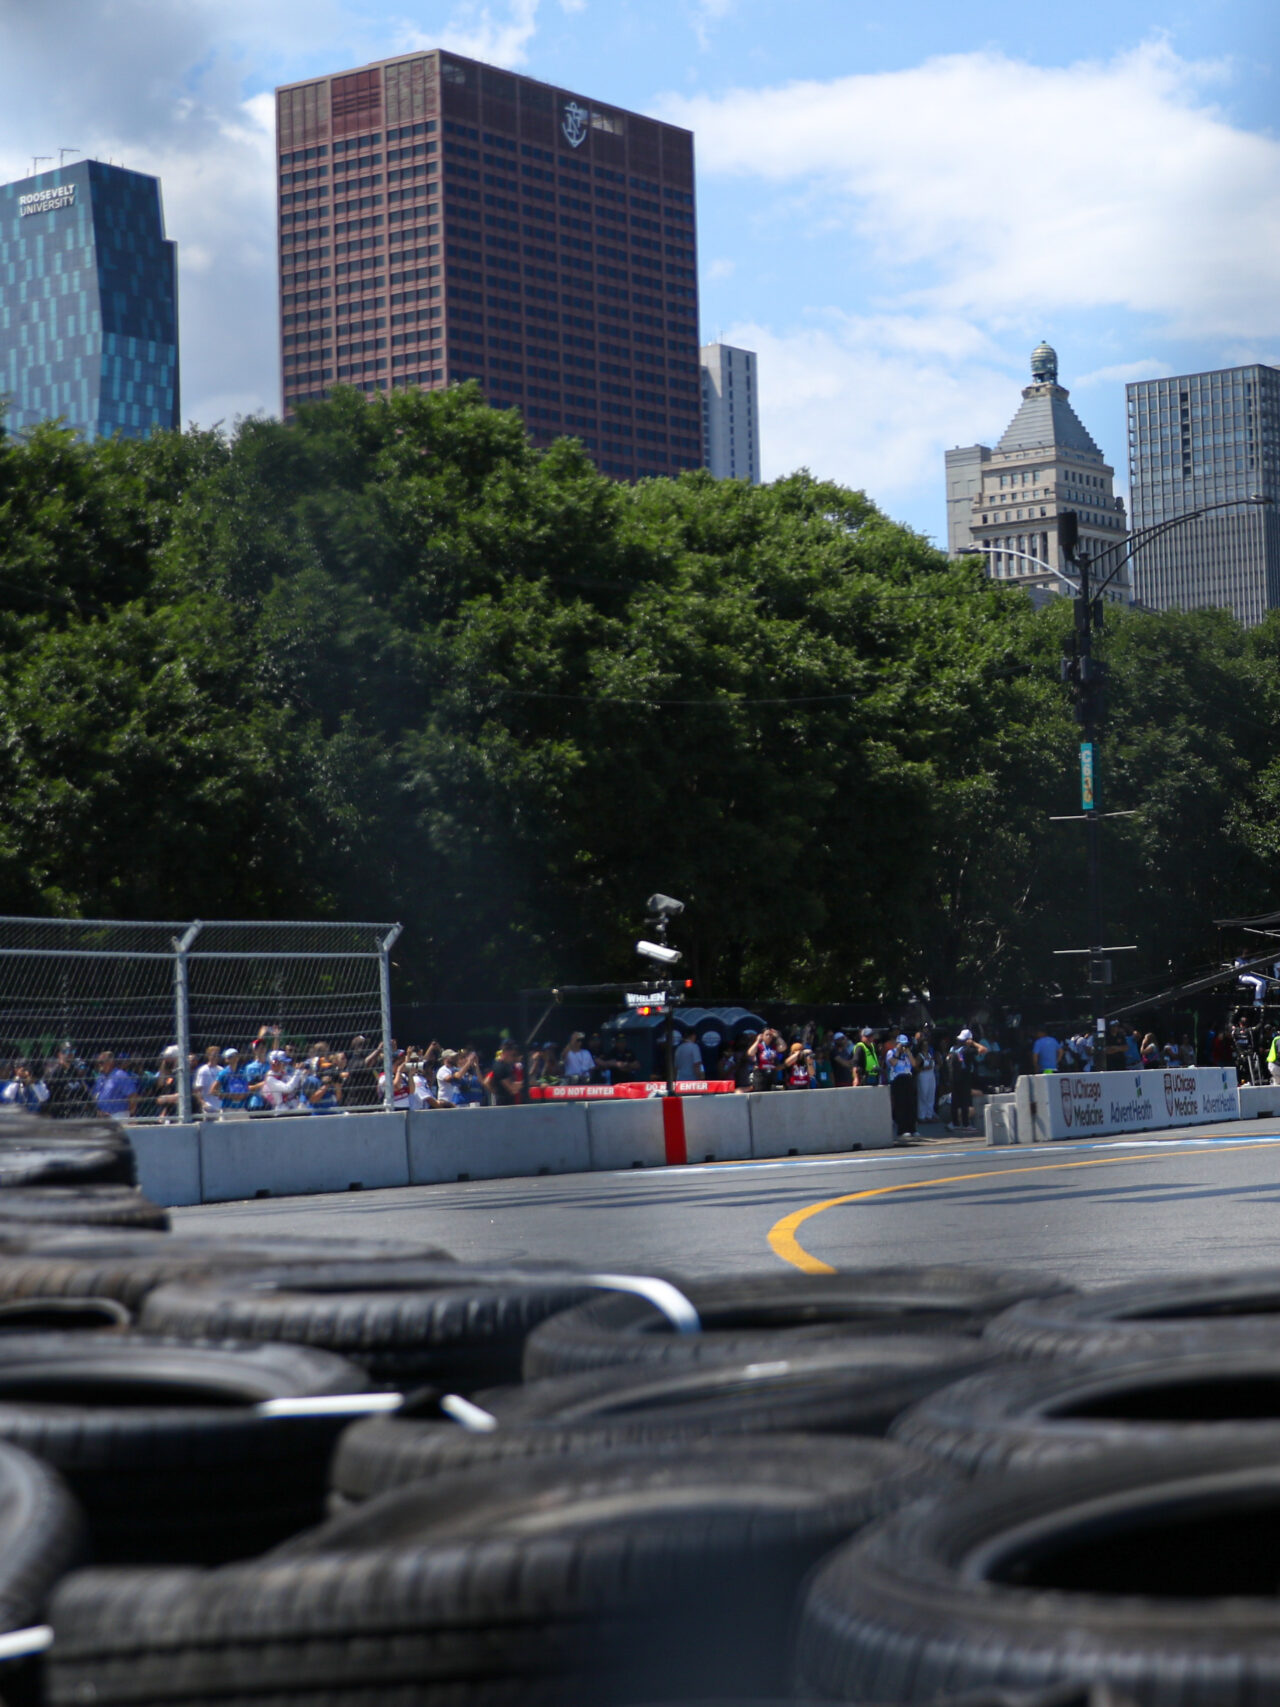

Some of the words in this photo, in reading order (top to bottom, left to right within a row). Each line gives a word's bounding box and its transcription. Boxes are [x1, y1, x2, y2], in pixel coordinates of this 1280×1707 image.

[19, 184, 76, 205] ROOSEVELT
[19, 195, 76, 217] UNIVERSITY
[627, 991, 666, 1003] WHELEN
[554, 1088, 565, 1096] DO
[568, 1087, 584, 1096] NOT
[586, 1087, 614, 1095] ENTER
[680, 1082, 708, 1091] ENTER
[1072, 1079, 1102, 1101] UChicago
[1172, 1073, 1196, 1095] UChicago
[1074, 1103, 1104, 1127] Medicine
[1110, 1099, 1153, 1124] AdventHealth
[1174, 1096, 1198, 1116] Medicine
